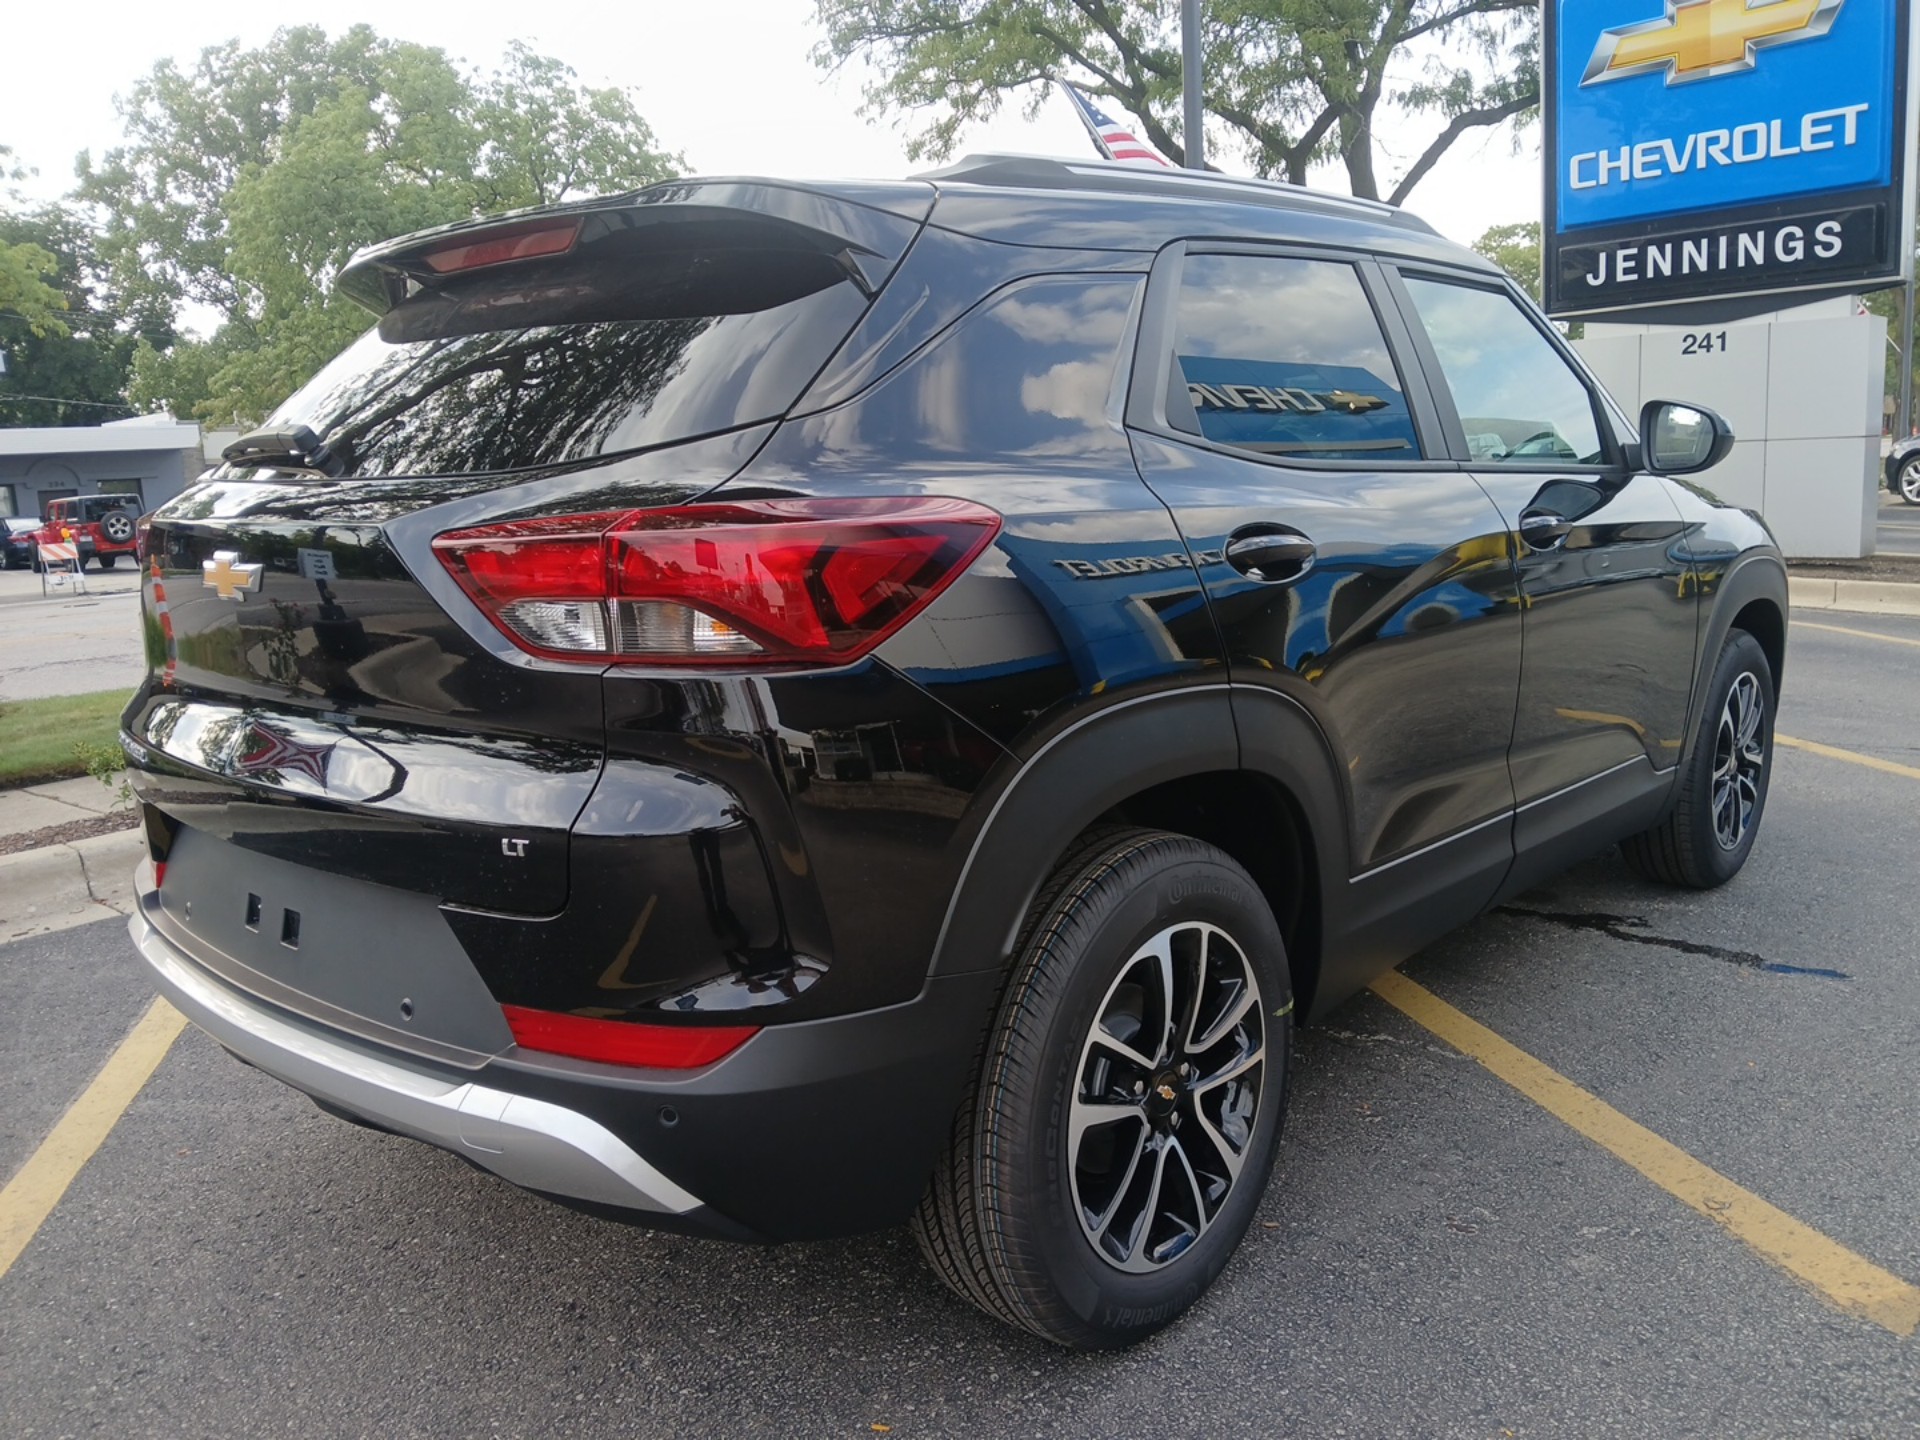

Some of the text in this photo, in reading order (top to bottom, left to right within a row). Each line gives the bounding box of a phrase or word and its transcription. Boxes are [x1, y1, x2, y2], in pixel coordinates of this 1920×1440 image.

[1569, 103, 1869, 190] CHEVROLET
[1585, 220, 1843, 287] JENNINGS
[1681, 331, 1728, 355] 241
[501, 838, 530, 857] LT
